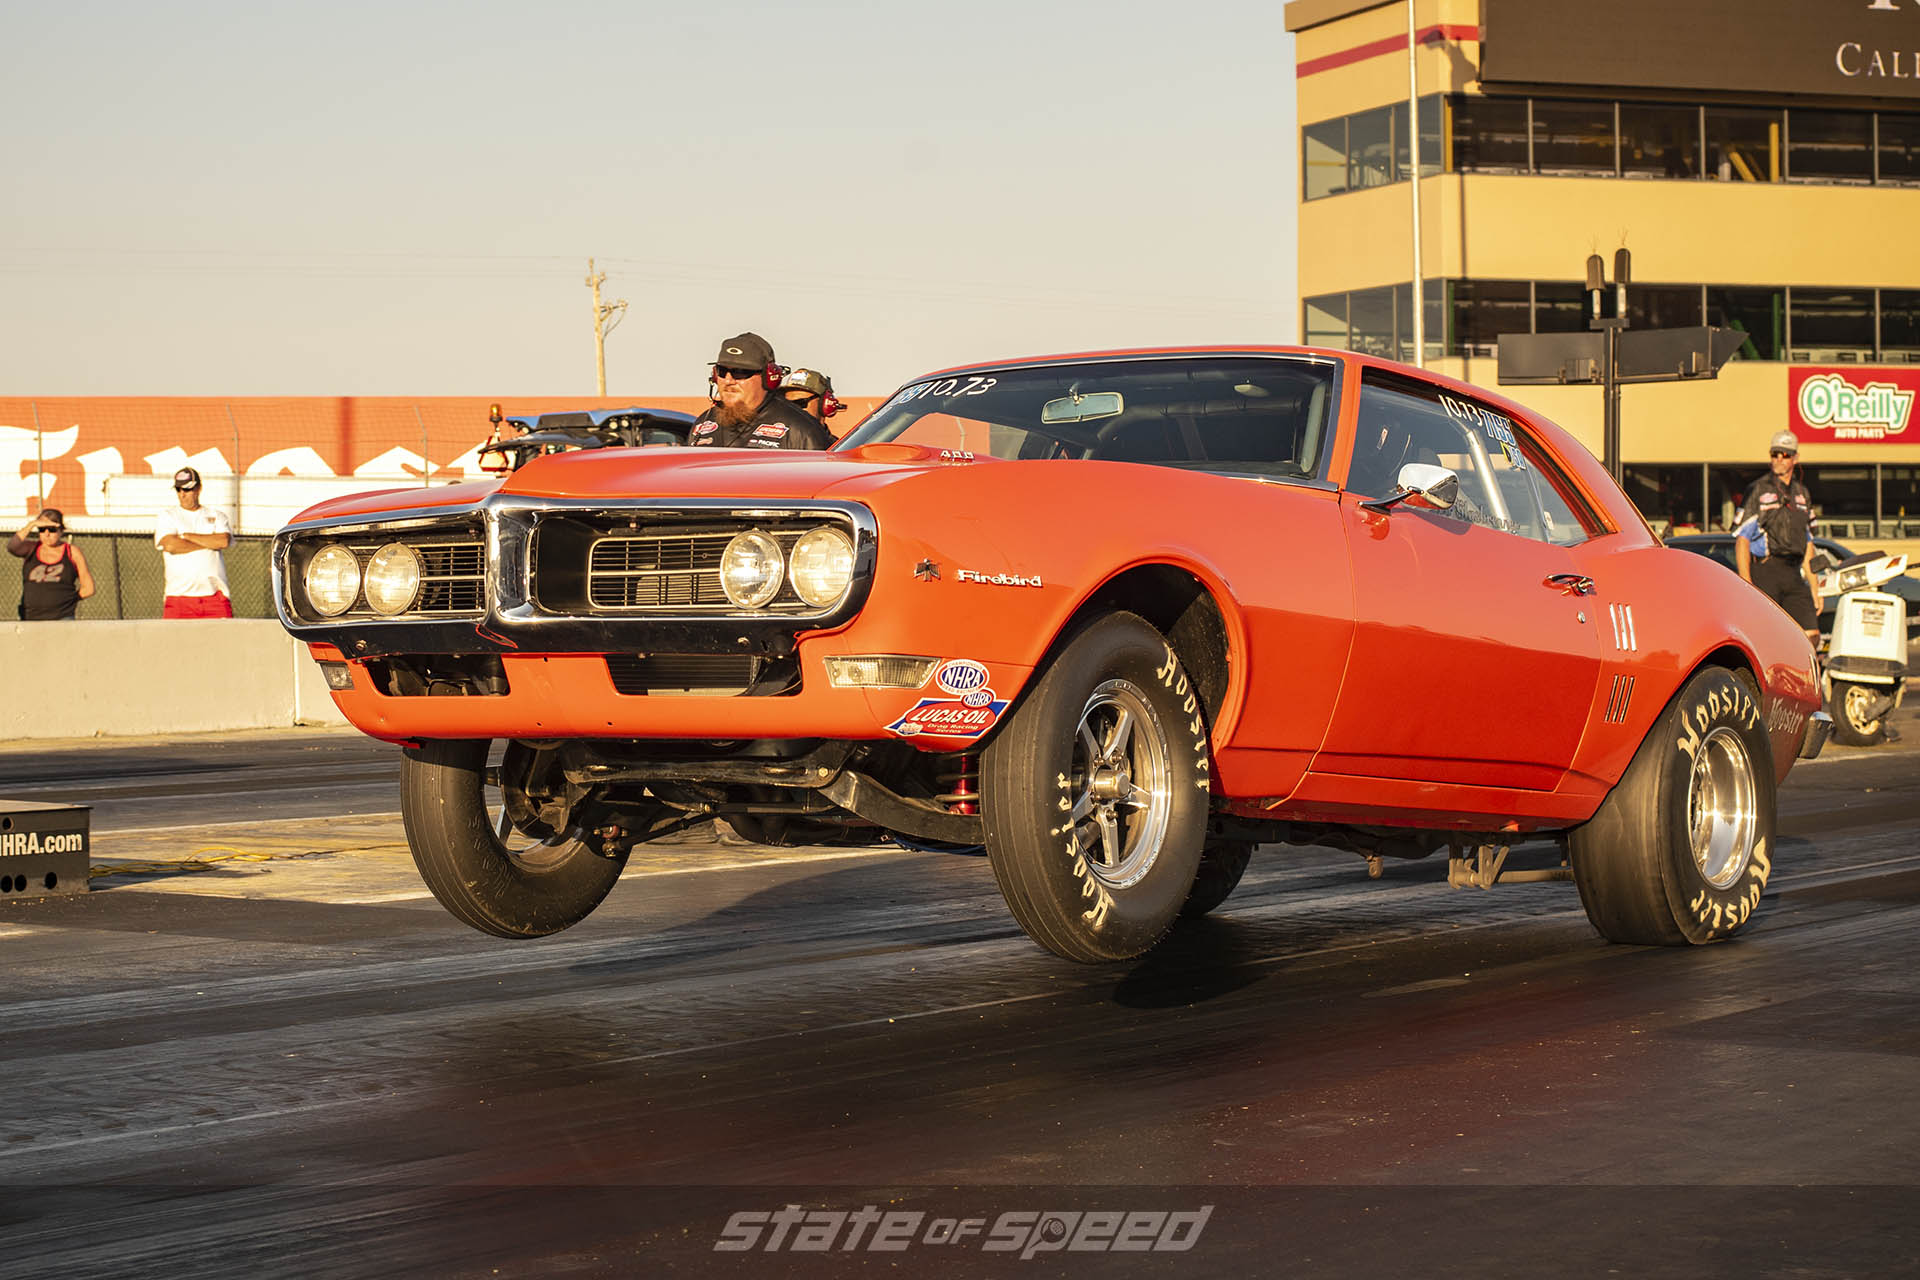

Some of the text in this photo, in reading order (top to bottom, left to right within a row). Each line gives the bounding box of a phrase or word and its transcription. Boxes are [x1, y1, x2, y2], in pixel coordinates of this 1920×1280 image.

[918, 377, 997, 399] 10.73
[1438, 394, 1483, 427] 10.73
[1805, 382, 1906, 425] O'Reilly
[1835, 428, 1885, 439] AUTO PARTS
[28, 563, 65, 583] 42
[958, 569, 1042, 587] Firebird
[944, 666, 981, 689] NHRA
[966, 693, 989, 706] NHRA
[910, 709, 990, 724] LUCAS OIL
[1156, 641, 1210, 793] Hoosier
[1677, 673, 1760, 760] Hoosier
[0, 832, 82, 857] HRA.com
[1050, 772, 1116, 928] Hoosier
[1690, 836, 1771, 938] Hoosier
